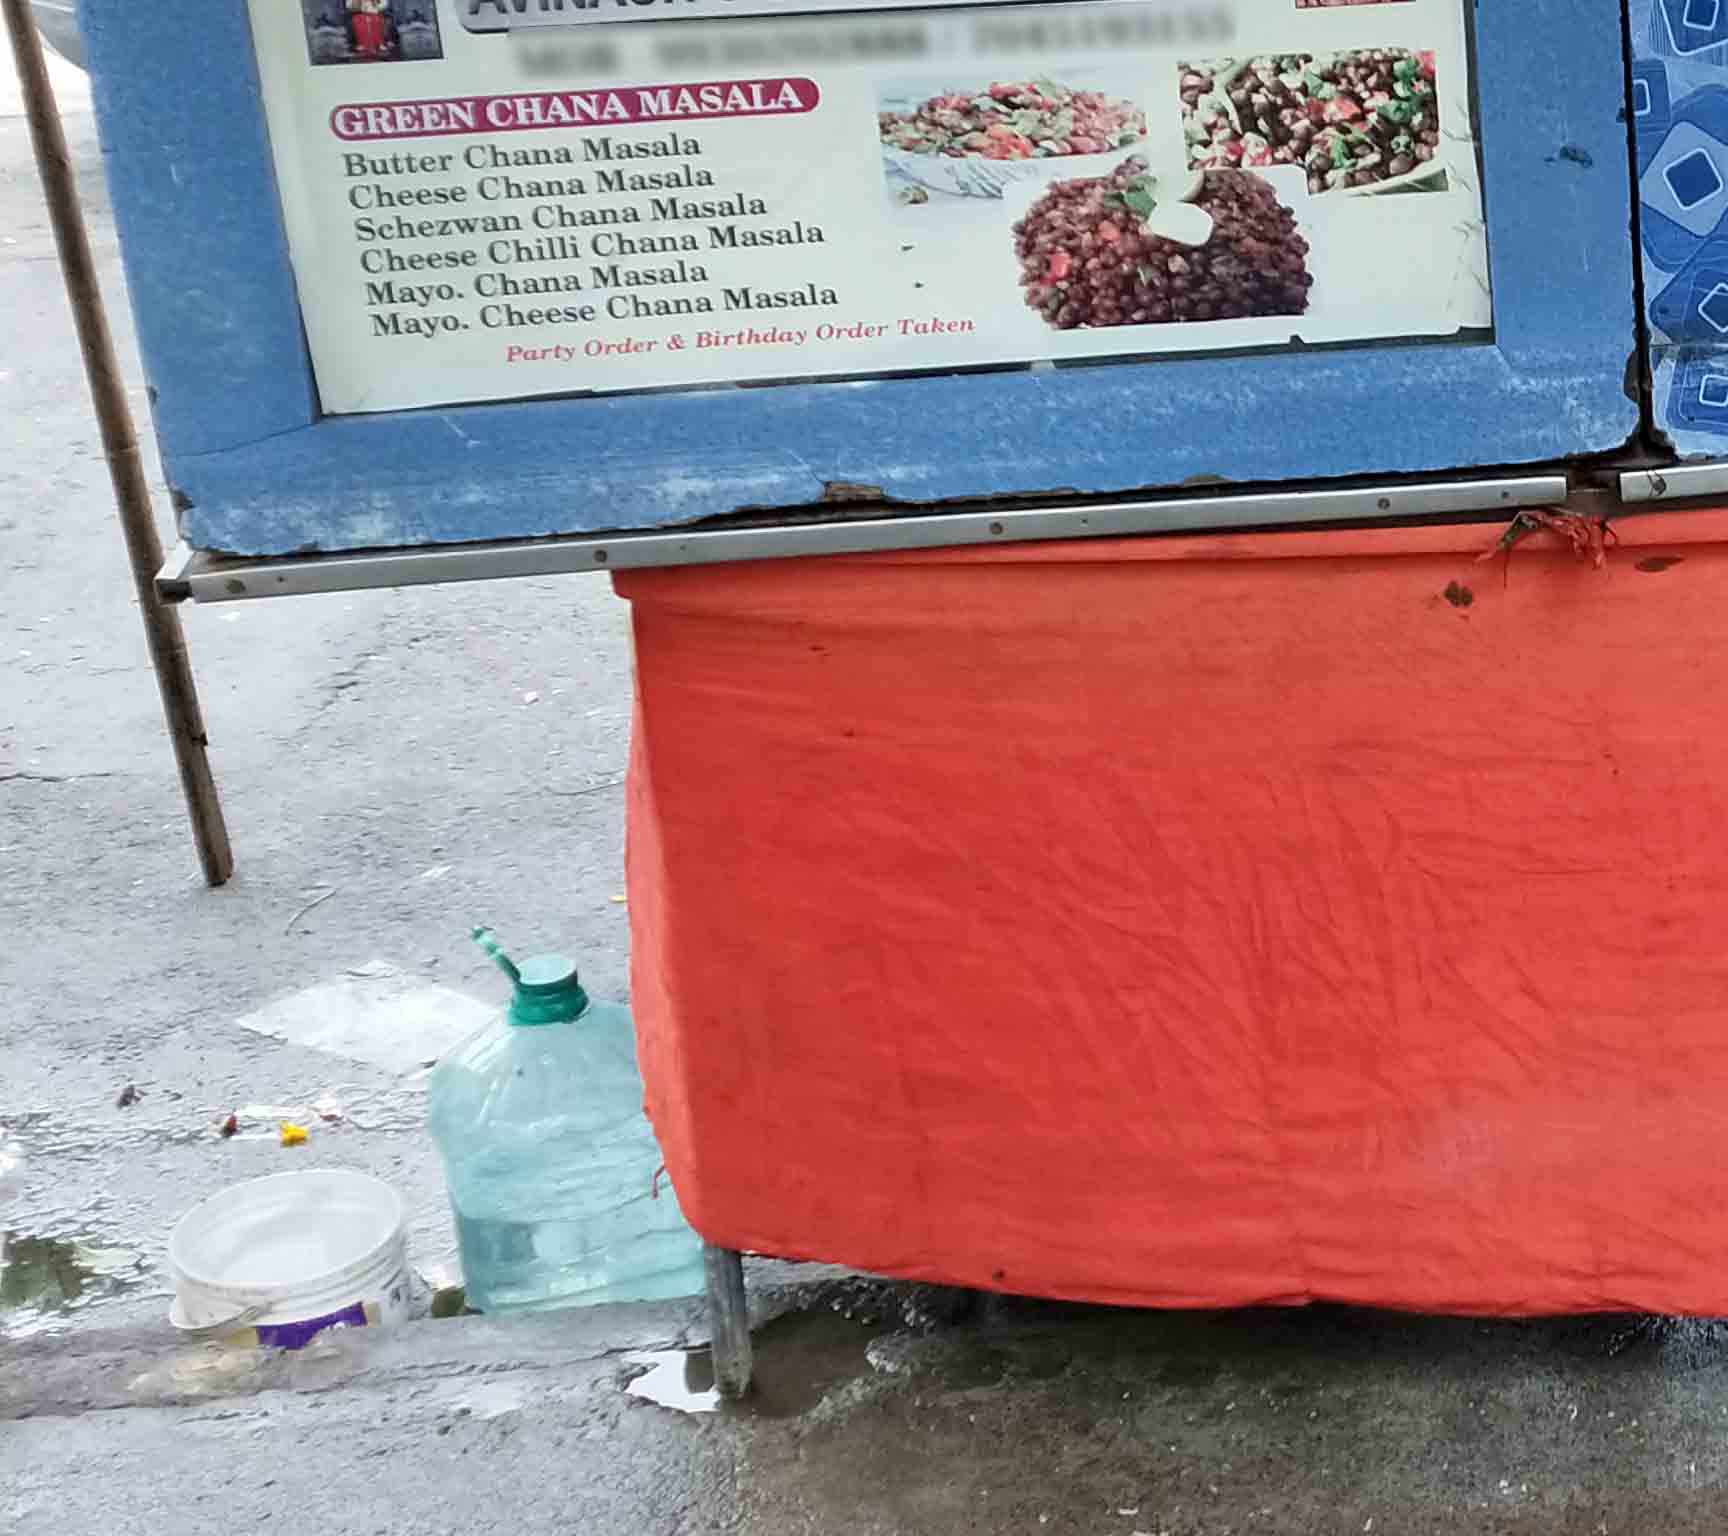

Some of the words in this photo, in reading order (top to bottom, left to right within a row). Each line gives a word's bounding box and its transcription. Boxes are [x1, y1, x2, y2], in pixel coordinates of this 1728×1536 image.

[334, 101, 475, 137] GREEN
[485, 93, 630, 127] CHANA
[638, 80, 805, 117] MASALA
[341, 152, 453, 178] Butter
[464, 143, 573, 169] Chana
[582, 132, 702, 162] Masala
[349, 184, 468, 210] Cheese
[477, 175, 587, 201] Chana
[595, 163, 716, 193] Masala
[353, 214, 523, 242] Schezwan
[532, 204, 640, 231] Chana
[649, 192, 768, 222] Masala
[360, 247, 478, 274] Cheese
[488, 234, 582, 266] Chilli
[590, 231, 699, 257] Chana
[707, 220, 825, 249] Masala
[364, 280, 465, 308] Mayo.
[474, 272, 583, 298] Chana
[589, 259, 709, 290] Masala
[368, 311, 470, 339] Mayo.
[479, 304, 596, 329] Cheese
[606, 293, 714, 320] Chana
[720, 283, 839, 312] Masala
[506, 344, 577, 363] Party
[584, 337, 658, 358] Order
[666, 334, 686, 351] &
[695, 326, 808, 349] Birthday
[815, 320, 889, 341] Order
[897, 316, 977, 336] Taken
